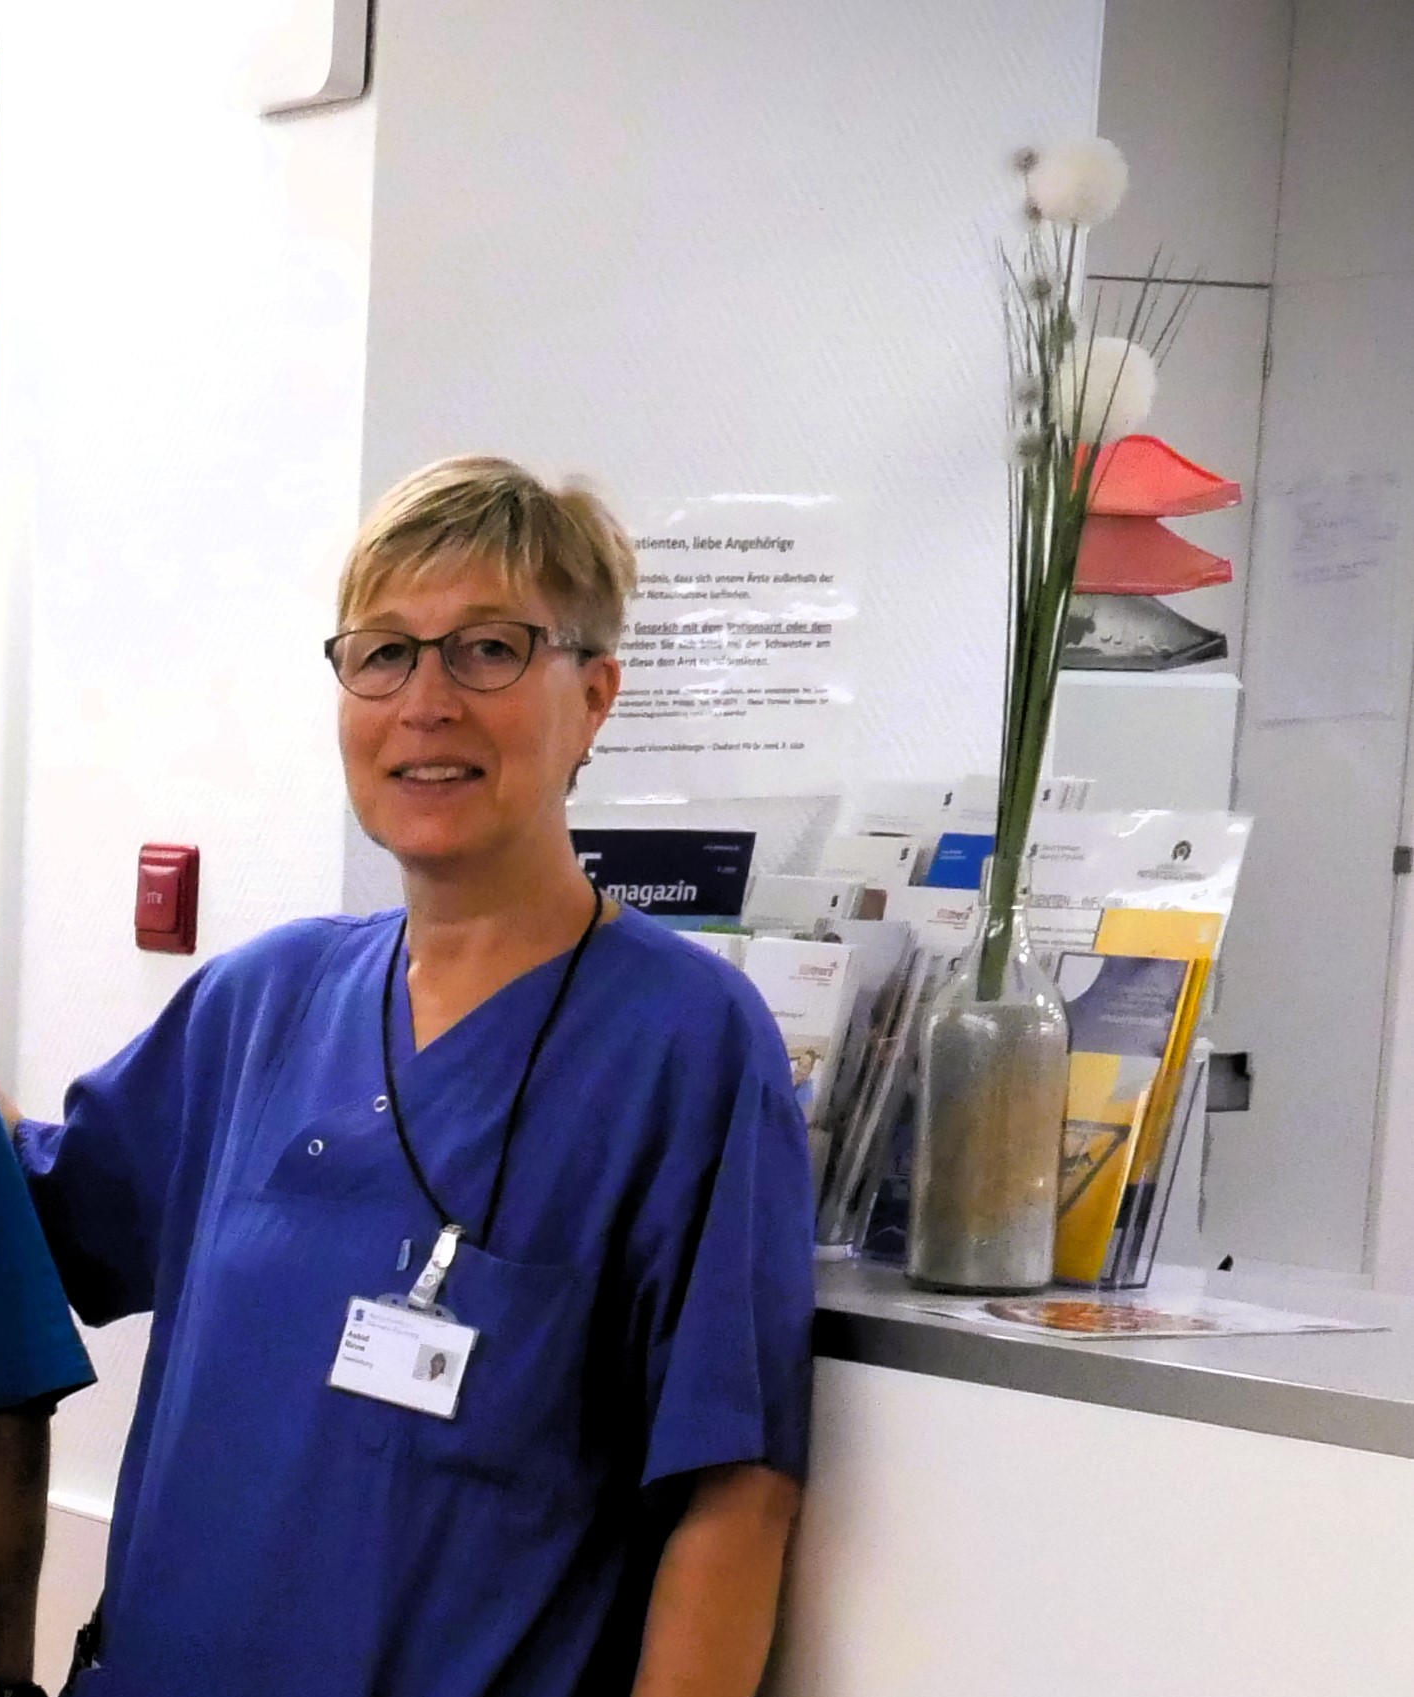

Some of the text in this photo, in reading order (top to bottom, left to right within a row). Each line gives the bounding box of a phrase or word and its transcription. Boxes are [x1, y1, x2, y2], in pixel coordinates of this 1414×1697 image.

[634, 536, 795, 553] atienten, liebe Angehörige
[606, 880, 698, 907] magazin
